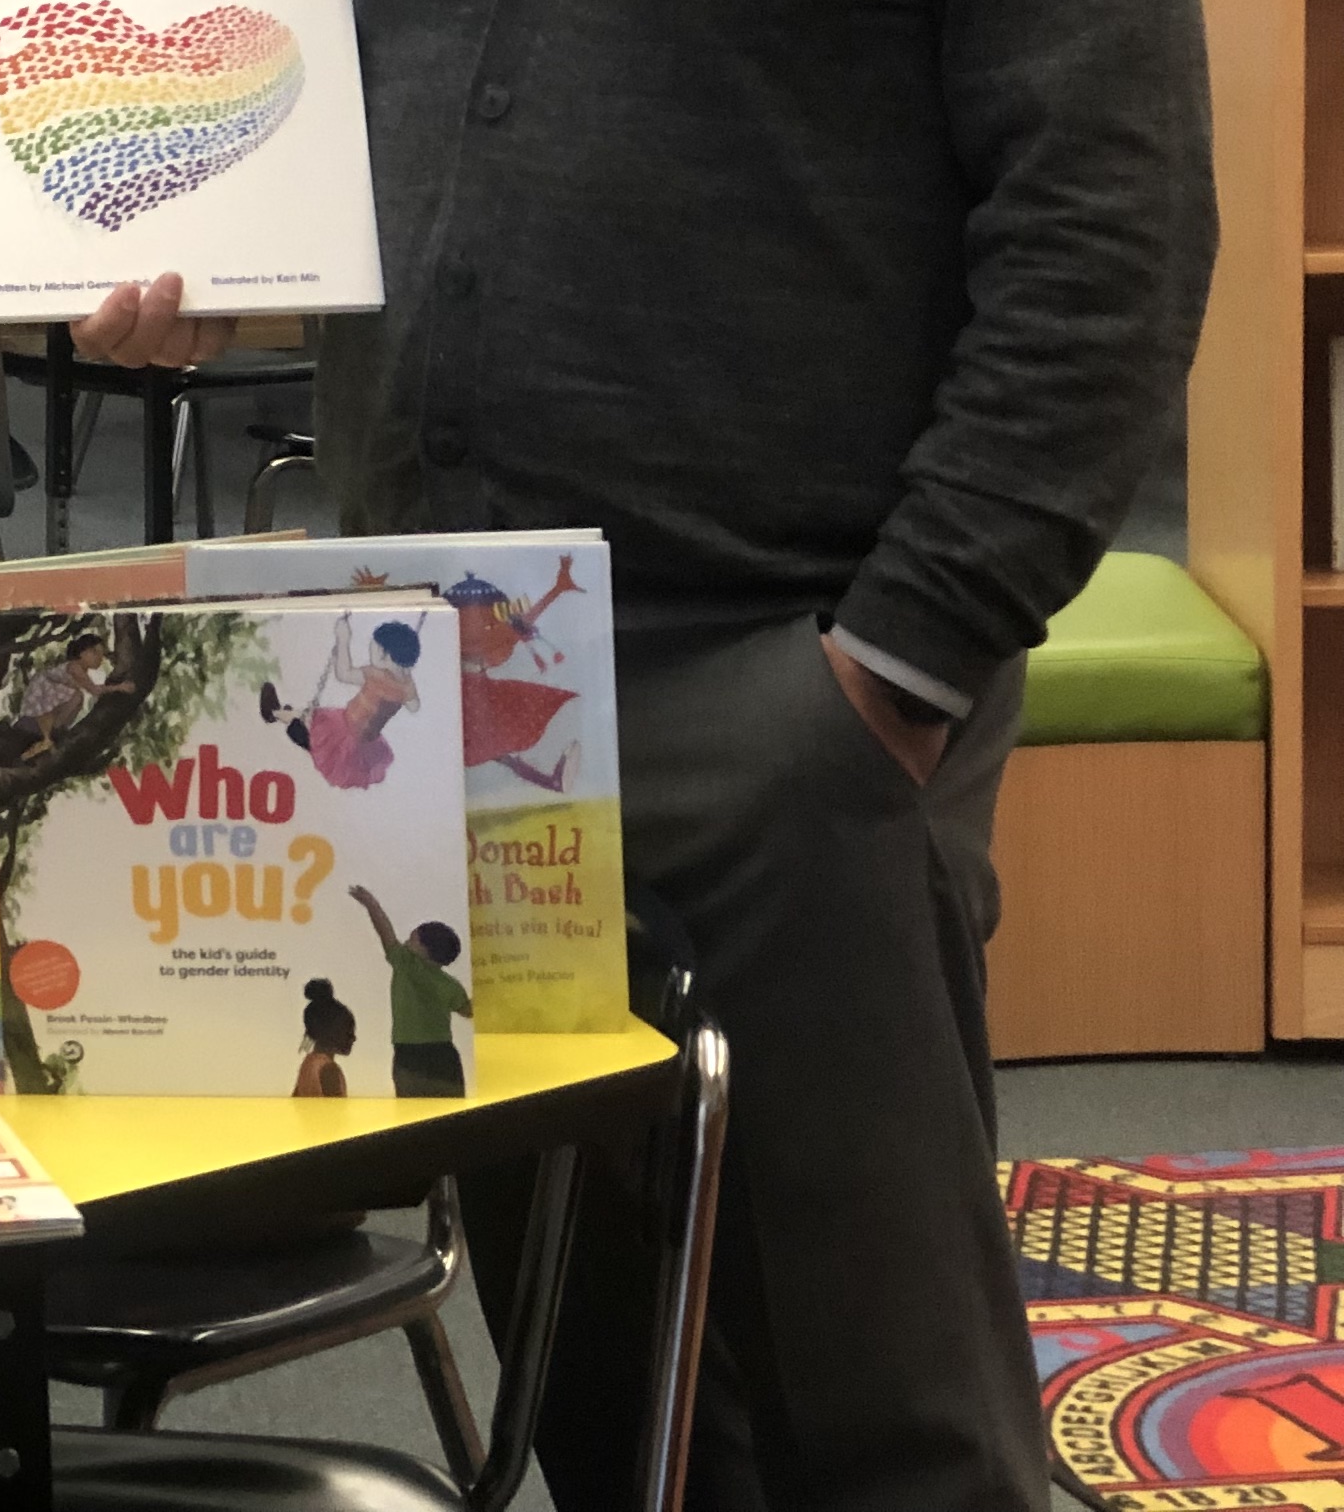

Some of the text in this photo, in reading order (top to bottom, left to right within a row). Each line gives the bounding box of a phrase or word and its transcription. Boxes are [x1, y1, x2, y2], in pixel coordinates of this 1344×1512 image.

[29, 284, 41, 293] by
[44, 281, 84, 291] Michael
[169, 819, 257, 857] are
[131, 835, 335, 945] you?
[172, 948, 277, 963] the kid's guide
[159, 965, 291, 980] to gender identity
